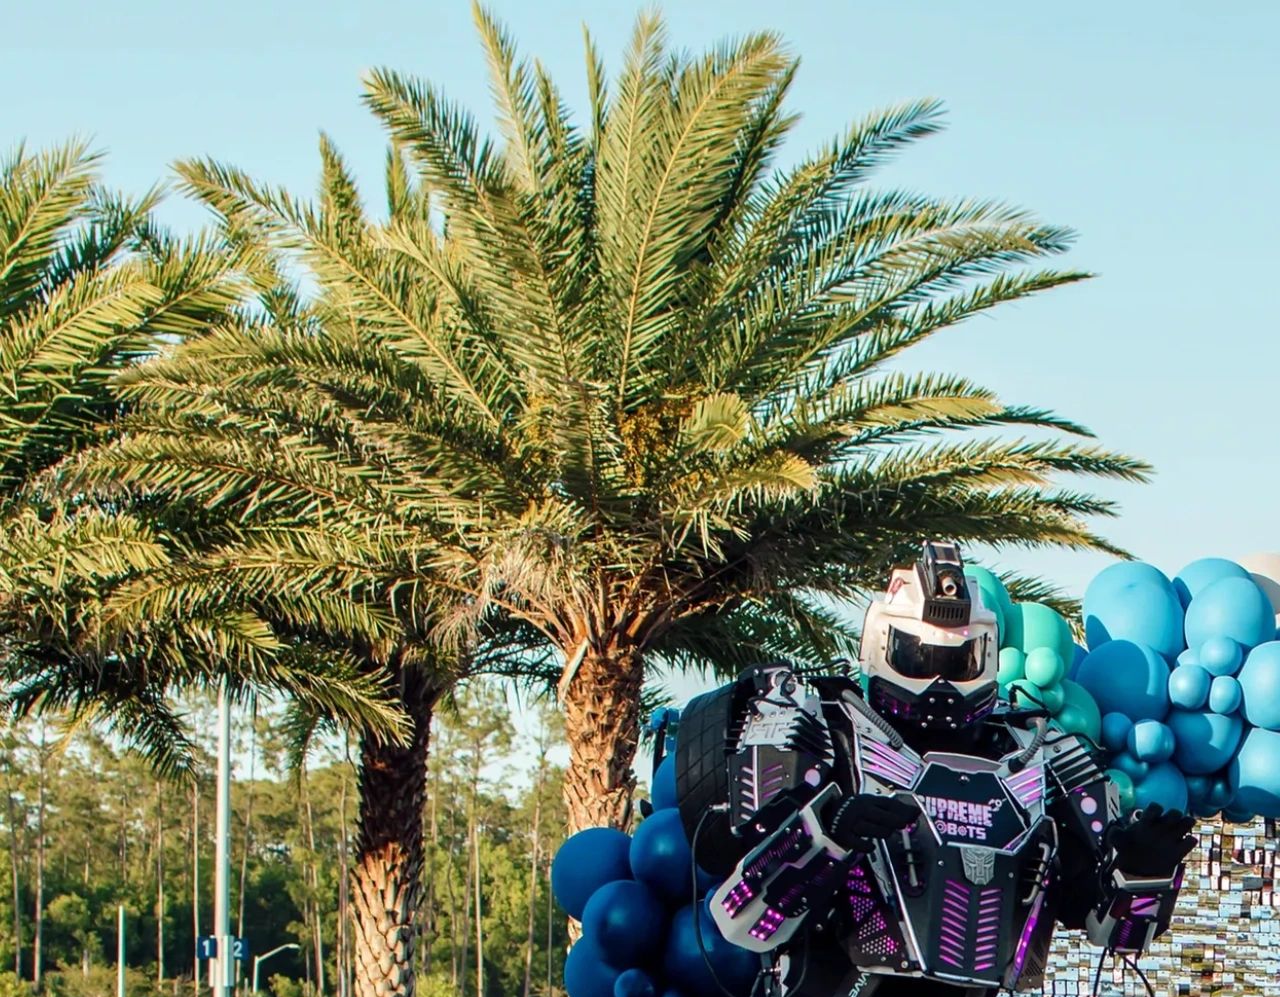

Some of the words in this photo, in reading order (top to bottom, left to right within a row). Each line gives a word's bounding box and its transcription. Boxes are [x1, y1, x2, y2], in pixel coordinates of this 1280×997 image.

[934, 819, 987, 840] OBOTS
[202, 939, 210, 957] 1
[233, 940, 243, 957] 2
